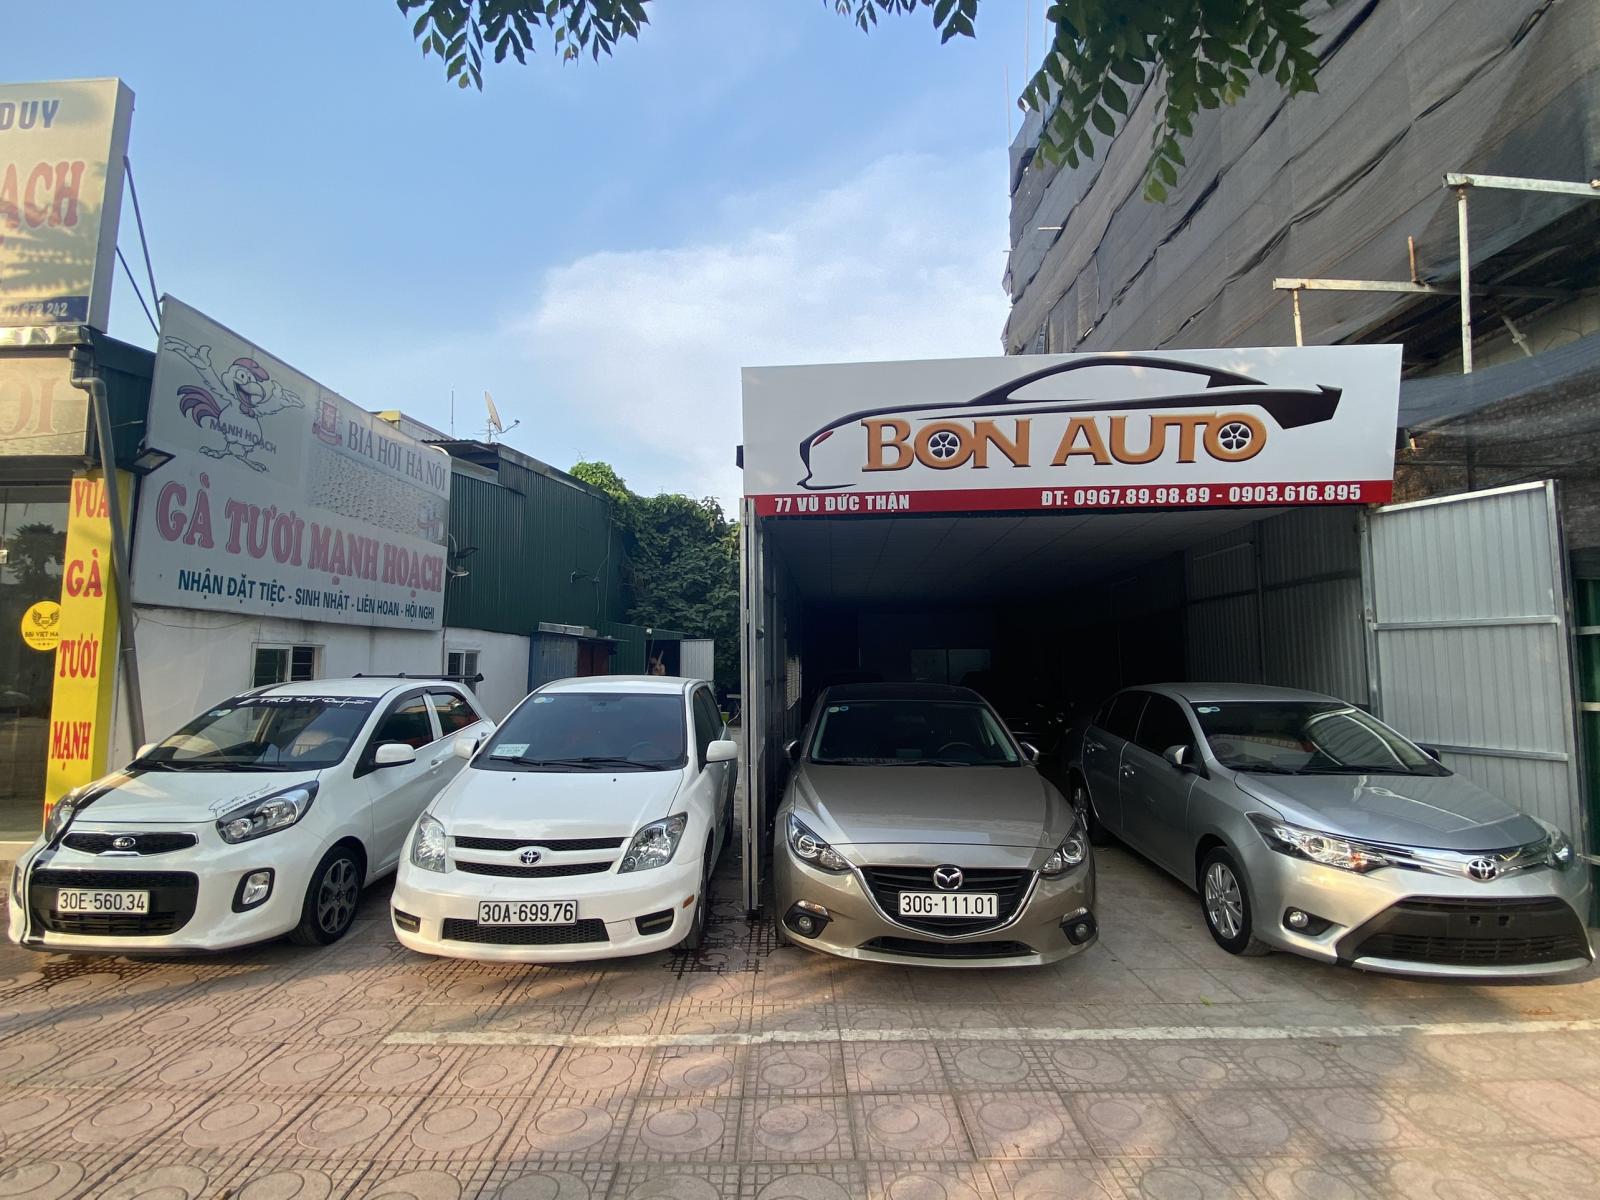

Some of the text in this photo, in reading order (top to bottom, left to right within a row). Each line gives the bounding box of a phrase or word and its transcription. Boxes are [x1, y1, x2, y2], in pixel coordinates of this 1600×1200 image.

[0, 100, 59, 130] DUY
[347, 420, 373, 459] BIA
[861, 411, 1267, 472] BON AUTO
[775, 493, 909, 512] 77 VŨ ĐỨC THẬN
[1041, 490, 1068, 506] ĐT:
[1074, 487, 1210, 506] 0967.89.98.89
[1229, 484, 1361, 503] 0903.616.895
[157, 473, 443, 598] GÀ TƯƠI MẠNH HOẠCH
[66, 548, 103, 597] GÀ
[178, 568, 223, 600] NHẬN
[260, 579, 286, 607] TIỆC
[295, 588, 321, 607] SINH
[323, 589, 349, 615] NHẬT
[356, 594, 376, 613] LIÊN
[377, 599, 400, 616] HOAN
[405, 601, 418, 622] HỘI
[418, 605, 435, 624] NGHỊ
[59, 633, 98, 678] TƯƠI
[51, 721, 92, 771] MẠNH
[60, 892, 145, 911] 30E-560.34
[481, 903, 574, 922] 30A-699.76
[902, 895, 993, 915] 30G-111.01
